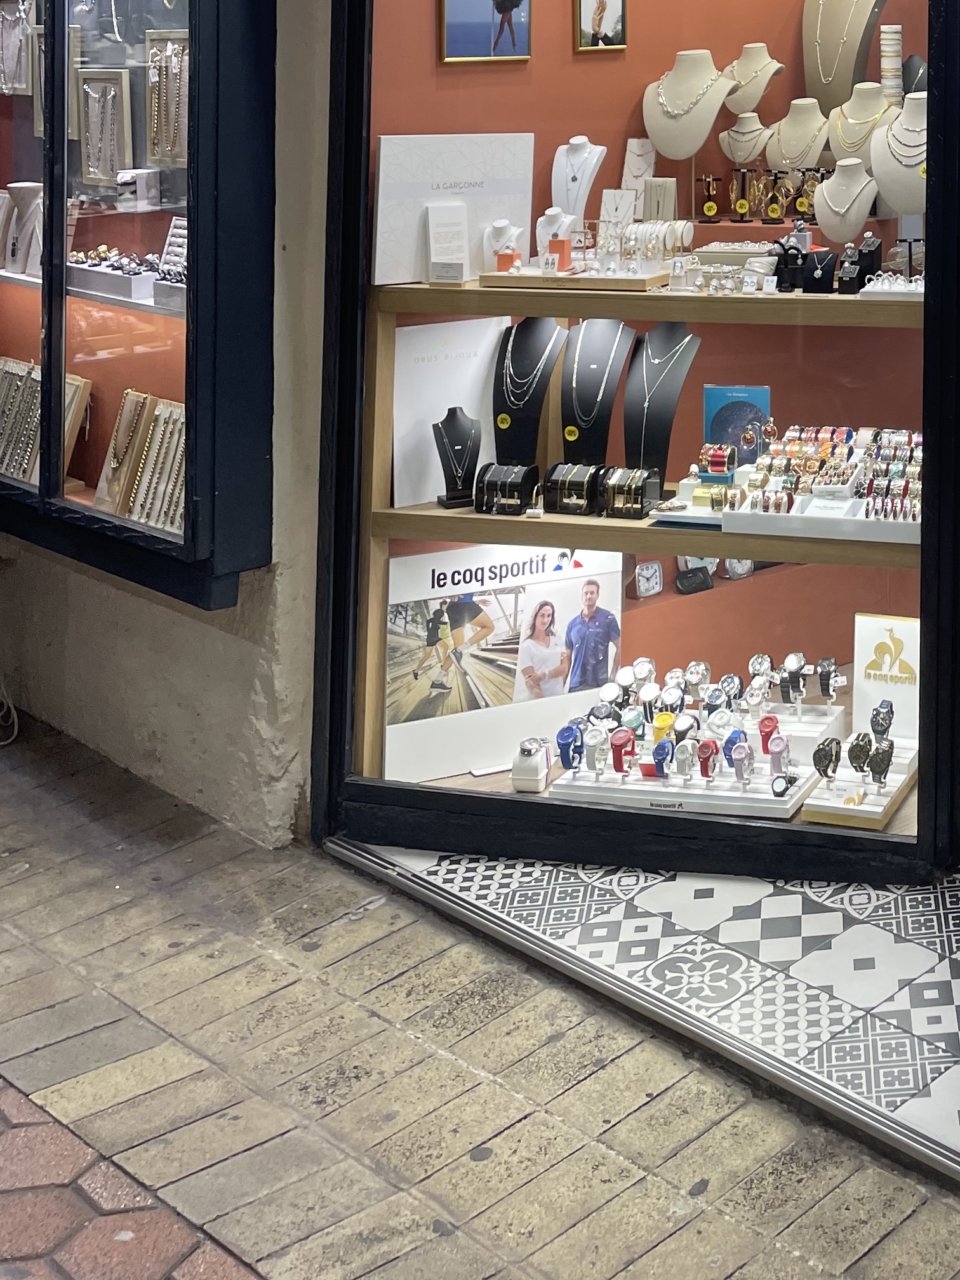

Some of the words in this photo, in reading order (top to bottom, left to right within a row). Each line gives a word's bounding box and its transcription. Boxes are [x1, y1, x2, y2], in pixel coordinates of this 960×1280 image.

[431, 568, 448, 589] le
[450, 566, 485, 587] coq
[488, 553, 547, 584] sportif
[864, 669, 872, 680] le
[872, 671, 889, 684] coq
